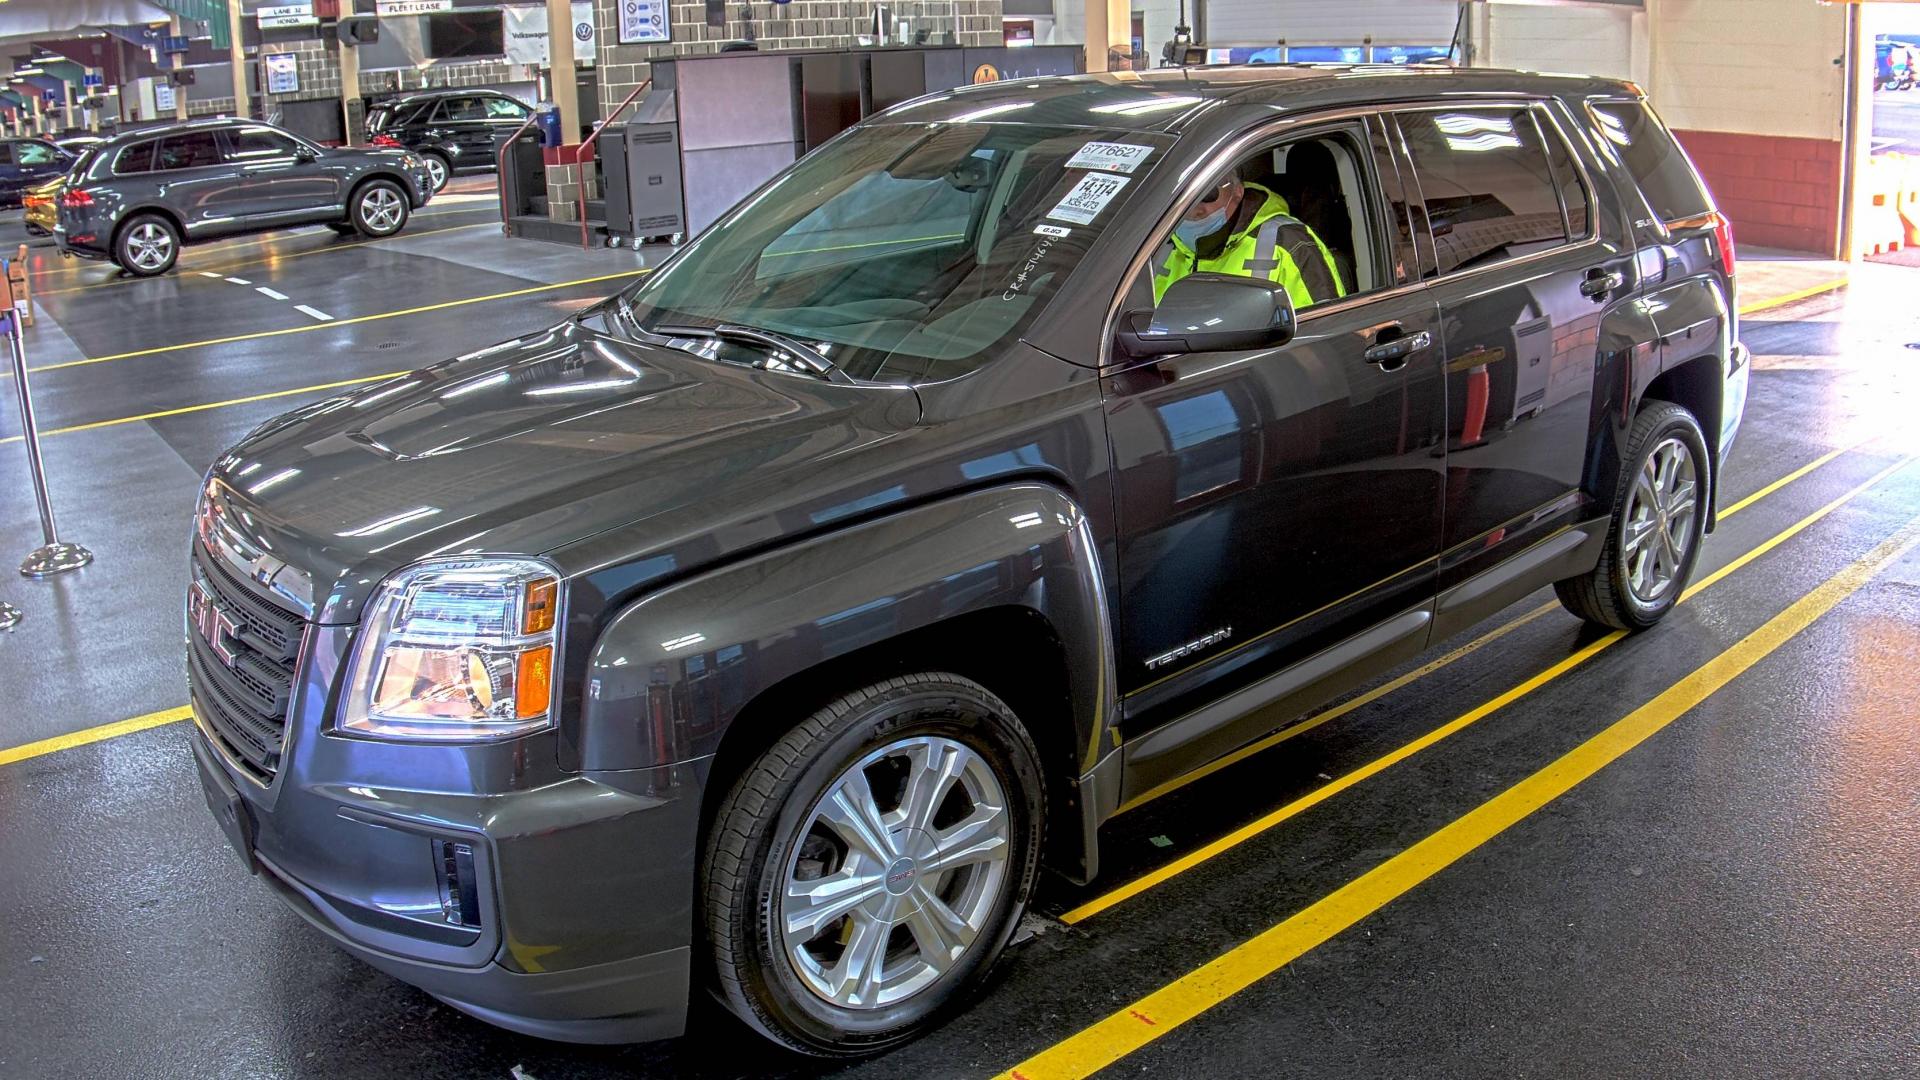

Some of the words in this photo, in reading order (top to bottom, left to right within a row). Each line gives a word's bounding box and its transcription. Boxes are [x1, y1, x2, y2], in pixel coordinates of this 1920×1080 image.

[388, 4, 413, 12] FLEET
[415, 3, 441, 11] LEASE
[1081, 144, 1144, 158] 6776621
[1078, 181, 1118, 196] 14:114
[1079, 192, 1101, 201] 2017
[188, 580, 239, 668] GMC
[1145, 626, 1232, 670] TERRAIN
